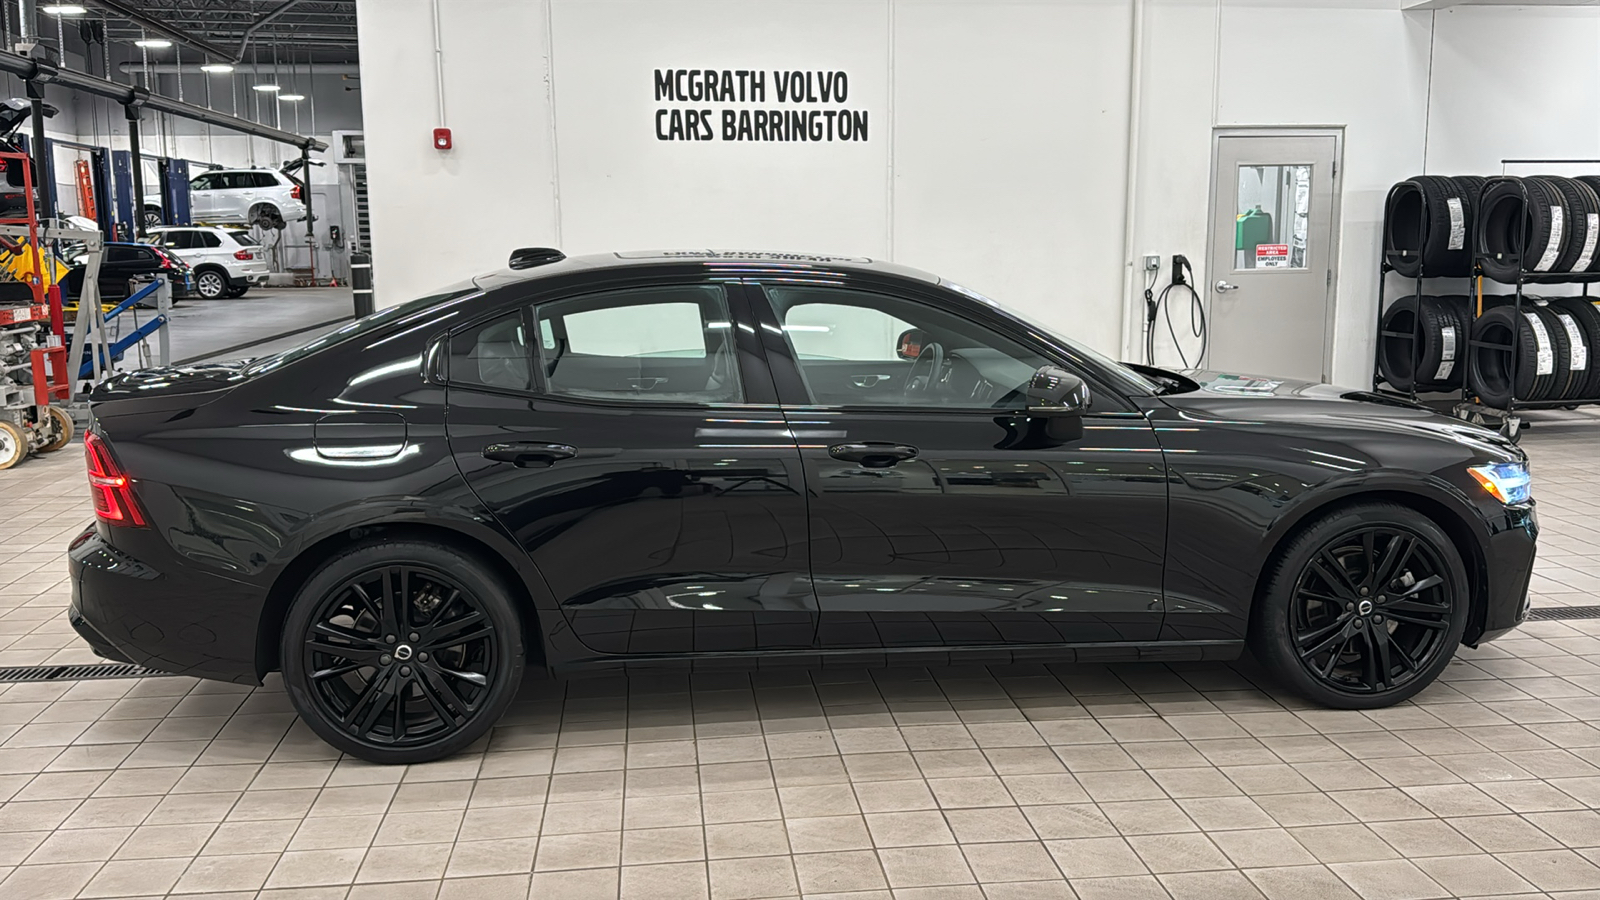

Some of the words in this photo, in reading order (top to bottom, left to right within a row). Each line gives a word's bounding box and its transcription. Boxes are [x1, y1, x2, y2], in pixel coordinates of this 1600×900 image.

[654, 69, 765, 102] MCGRATH
[773, 70, 848, 103] VOLVO
[655, 109, 714, 141] CARS
[722, 109, 868, 142] BARRINGTON
